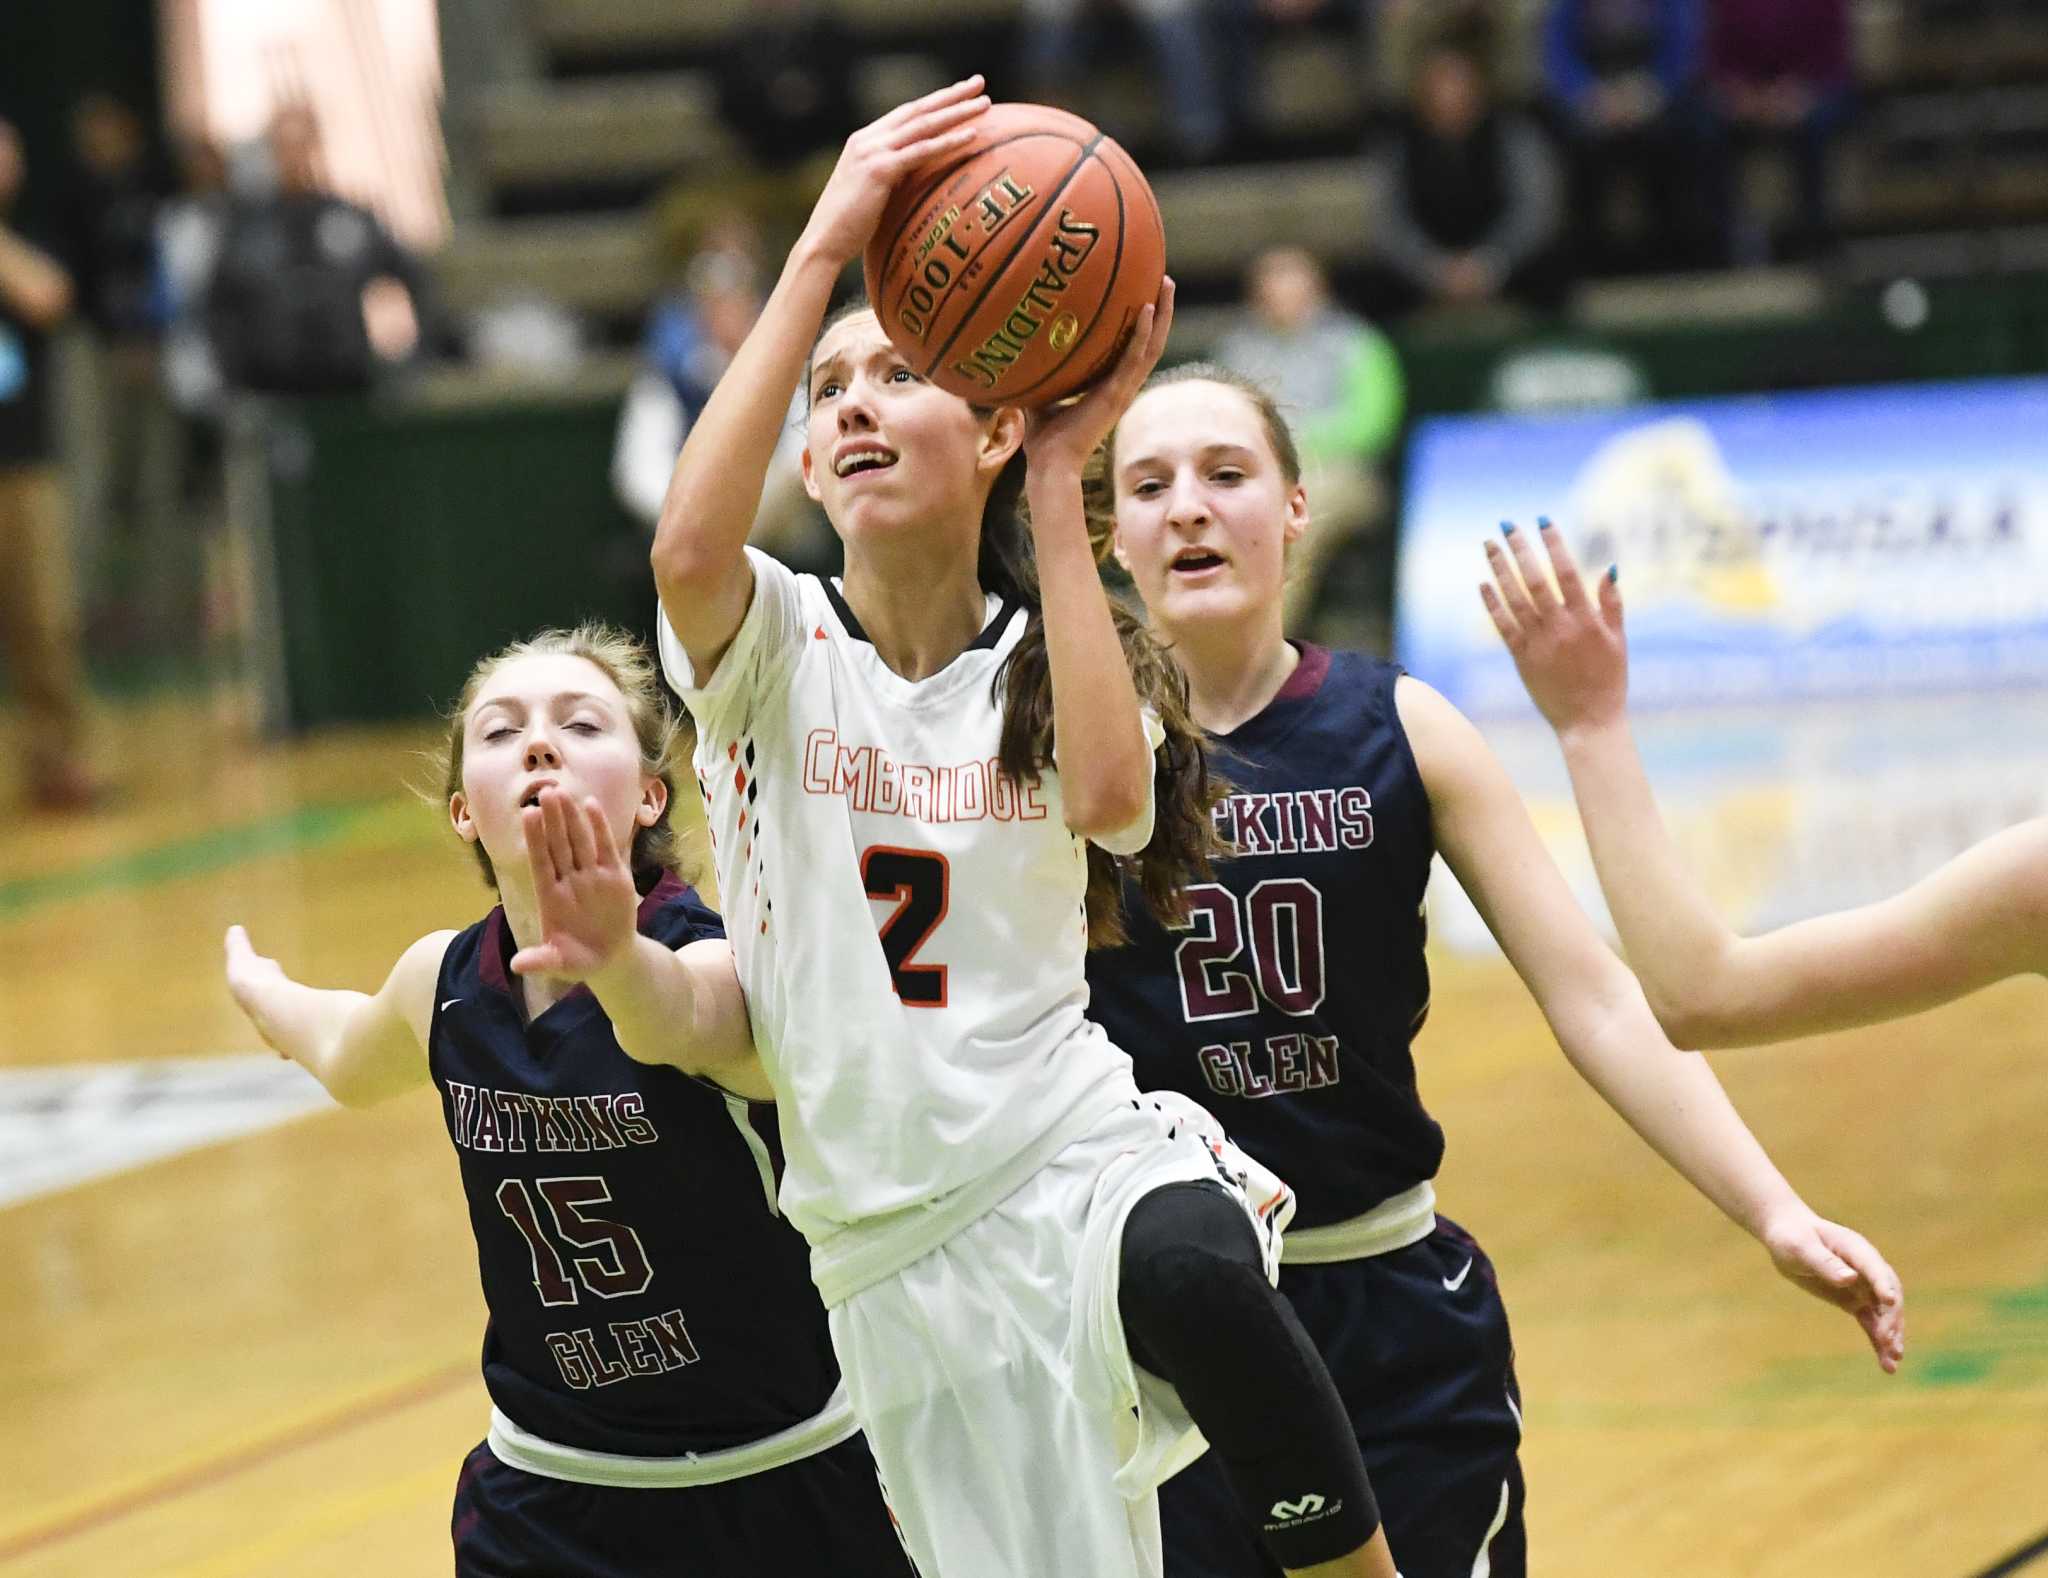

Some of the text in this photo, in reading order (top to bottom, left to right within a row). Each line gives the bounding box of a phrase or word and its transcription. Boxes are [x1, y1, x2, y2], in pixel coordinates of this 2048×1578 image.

[952, 208, 1099, 388] SPALDING
[803, 729, 1047, 823] CMBRIDGE
[860, 844, 950, 1008] 2
[1168, 878, 1326, 1023] 20
[446, 1079, 659, 1153] WATKINS
[1198, 1033, 1339, 1099] GLEN
[496, 1176, 654, 1306] 15
[545, 1309, 700, 1389] GLEN
